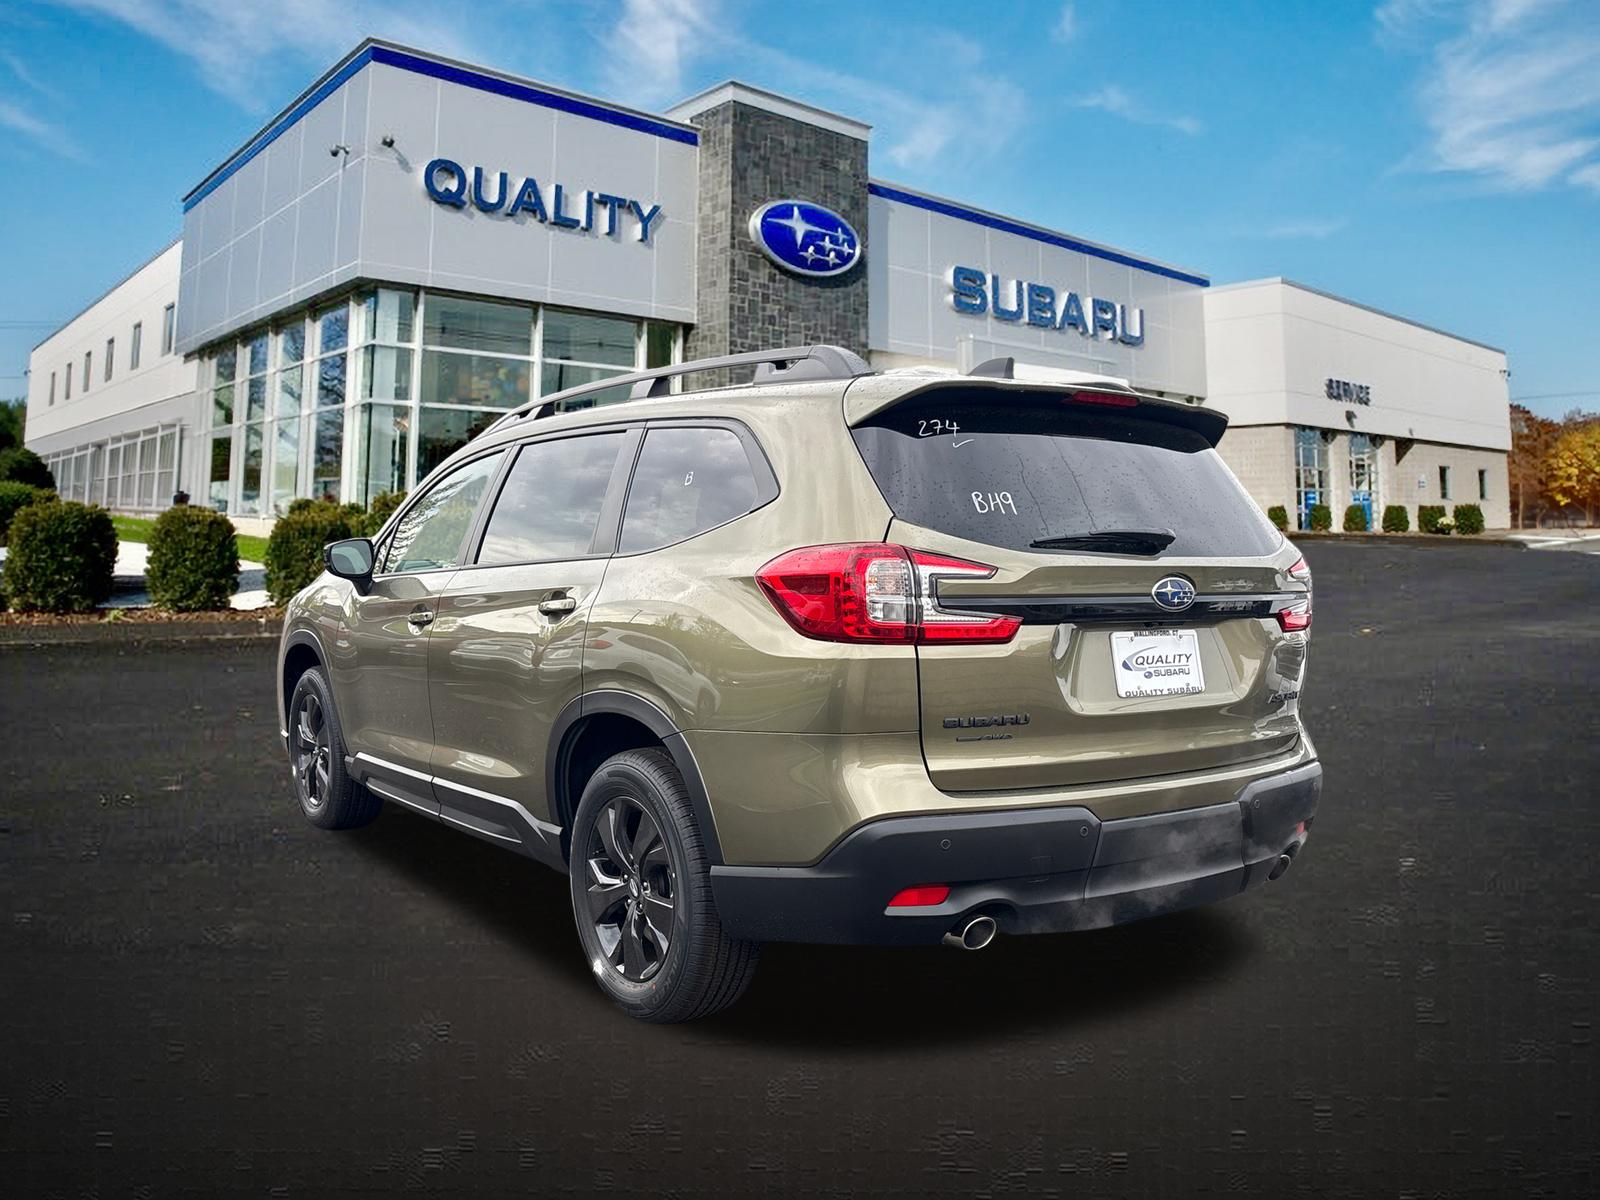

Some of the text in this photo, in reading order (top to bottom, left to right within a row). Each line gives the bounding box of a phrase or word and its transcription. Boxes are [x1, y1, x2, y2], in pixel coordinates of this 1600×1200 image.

[424, 158, 662, 243] QUALITY
[950, 265, 1146, 347] SUBARU
[918, 419, 960, 437] 274
[971, 491, 1018, 515] BH9
[1135, 653, 1192, 667] QUALITY
[1153, 668, 1191, 678] SUBARU
[1125, 685, 1203, 698] QUALITY SUBARU
[942, 714, 1031, 729] SUBARU
